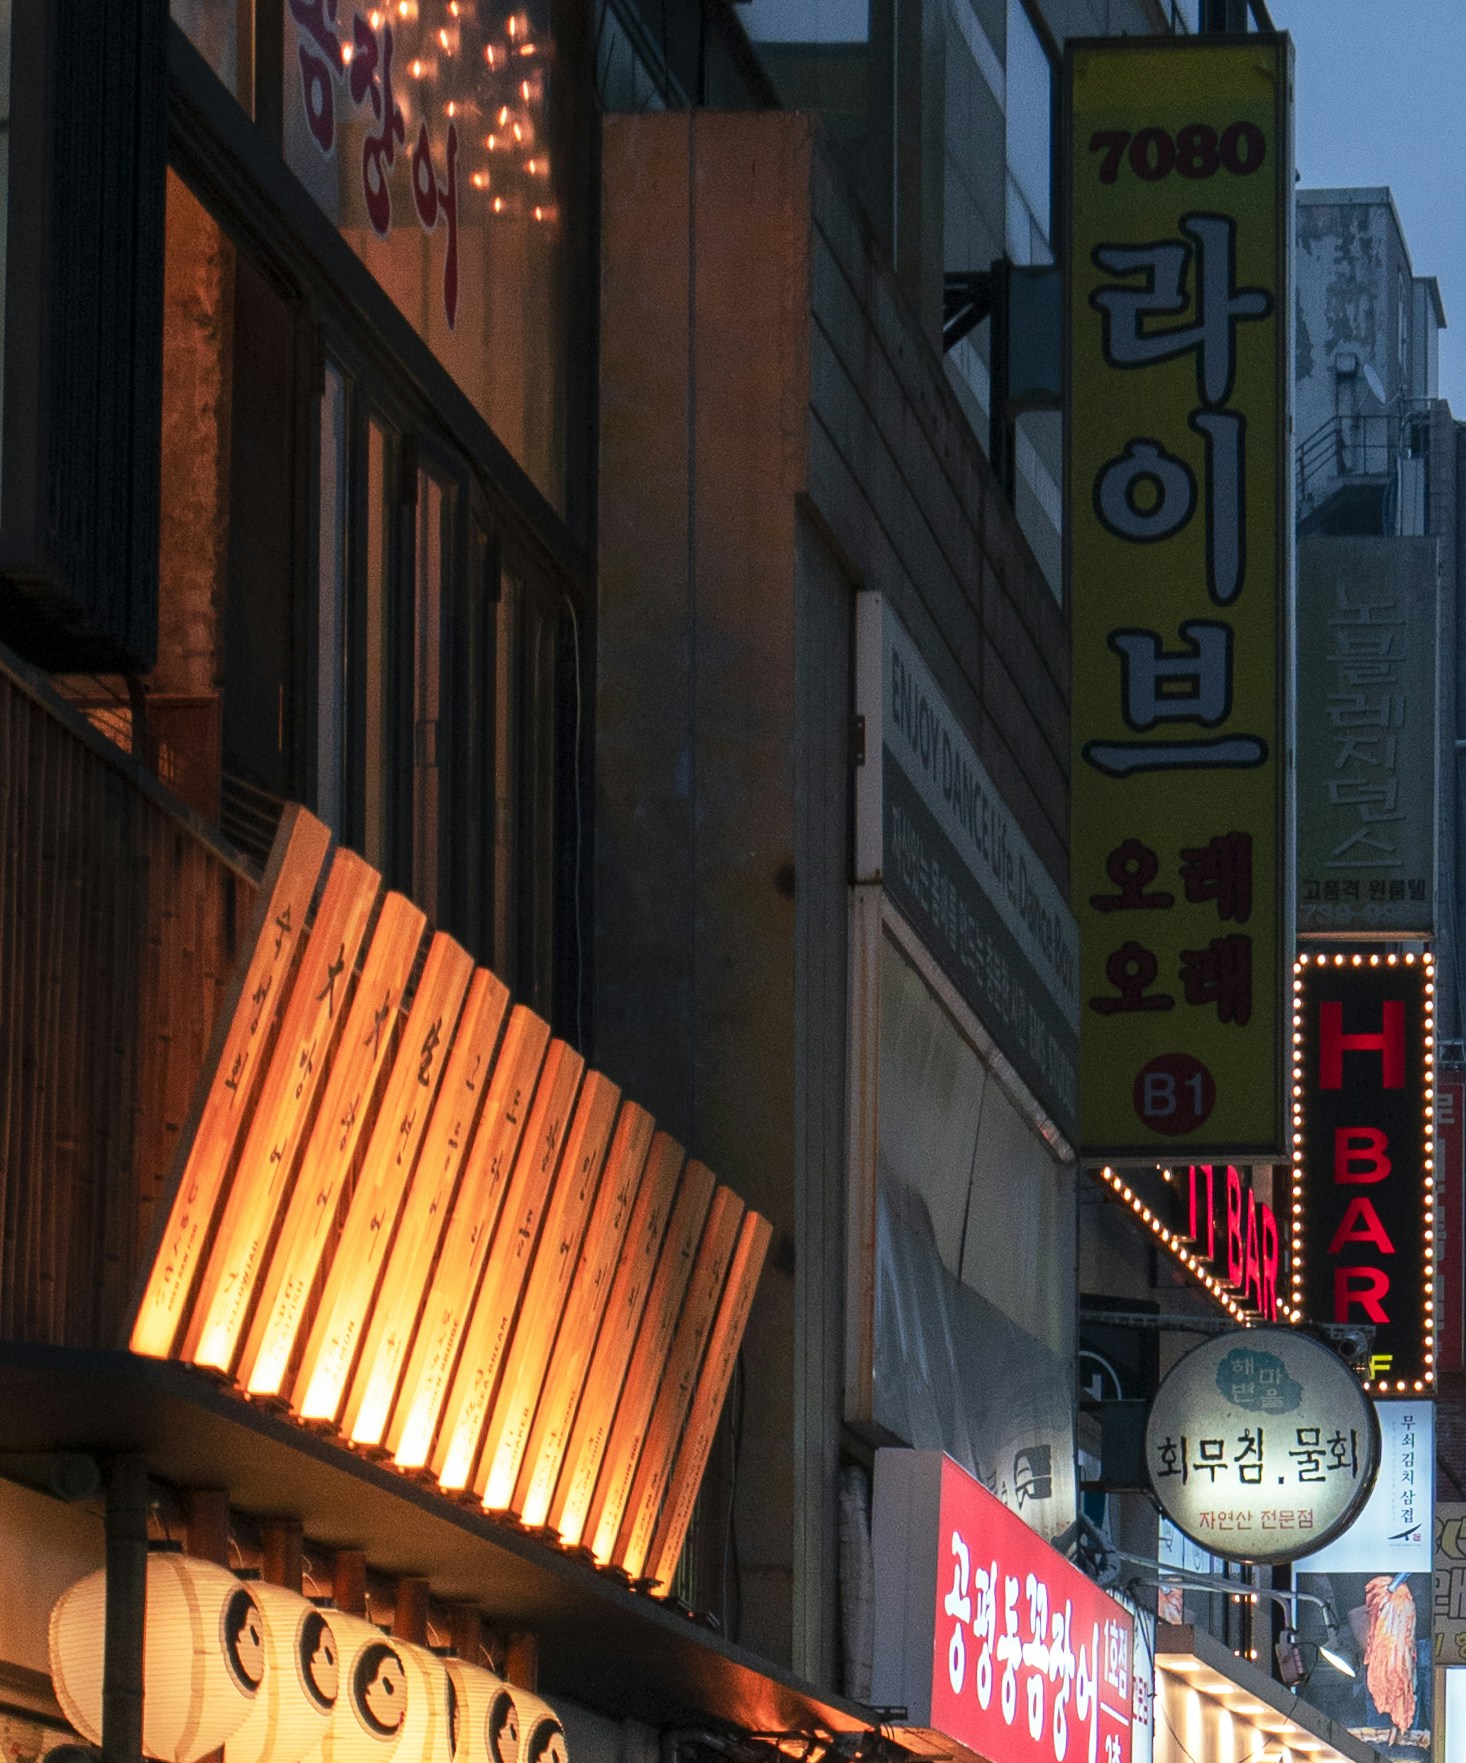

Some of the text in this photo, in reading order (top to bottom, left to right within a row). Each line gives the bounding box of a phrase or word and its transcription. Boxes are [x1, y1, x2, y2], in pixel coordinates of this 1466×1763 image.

[1089, 121, 1266, 183] 7080
[1083, 213, 1275, 780] 라이브
[1142, 1073, 1203, 1118] B1
[1199, 1509, 1315, 1532] 자연산 전문점
[1104, 1618, 1129, 1699] 1호점
